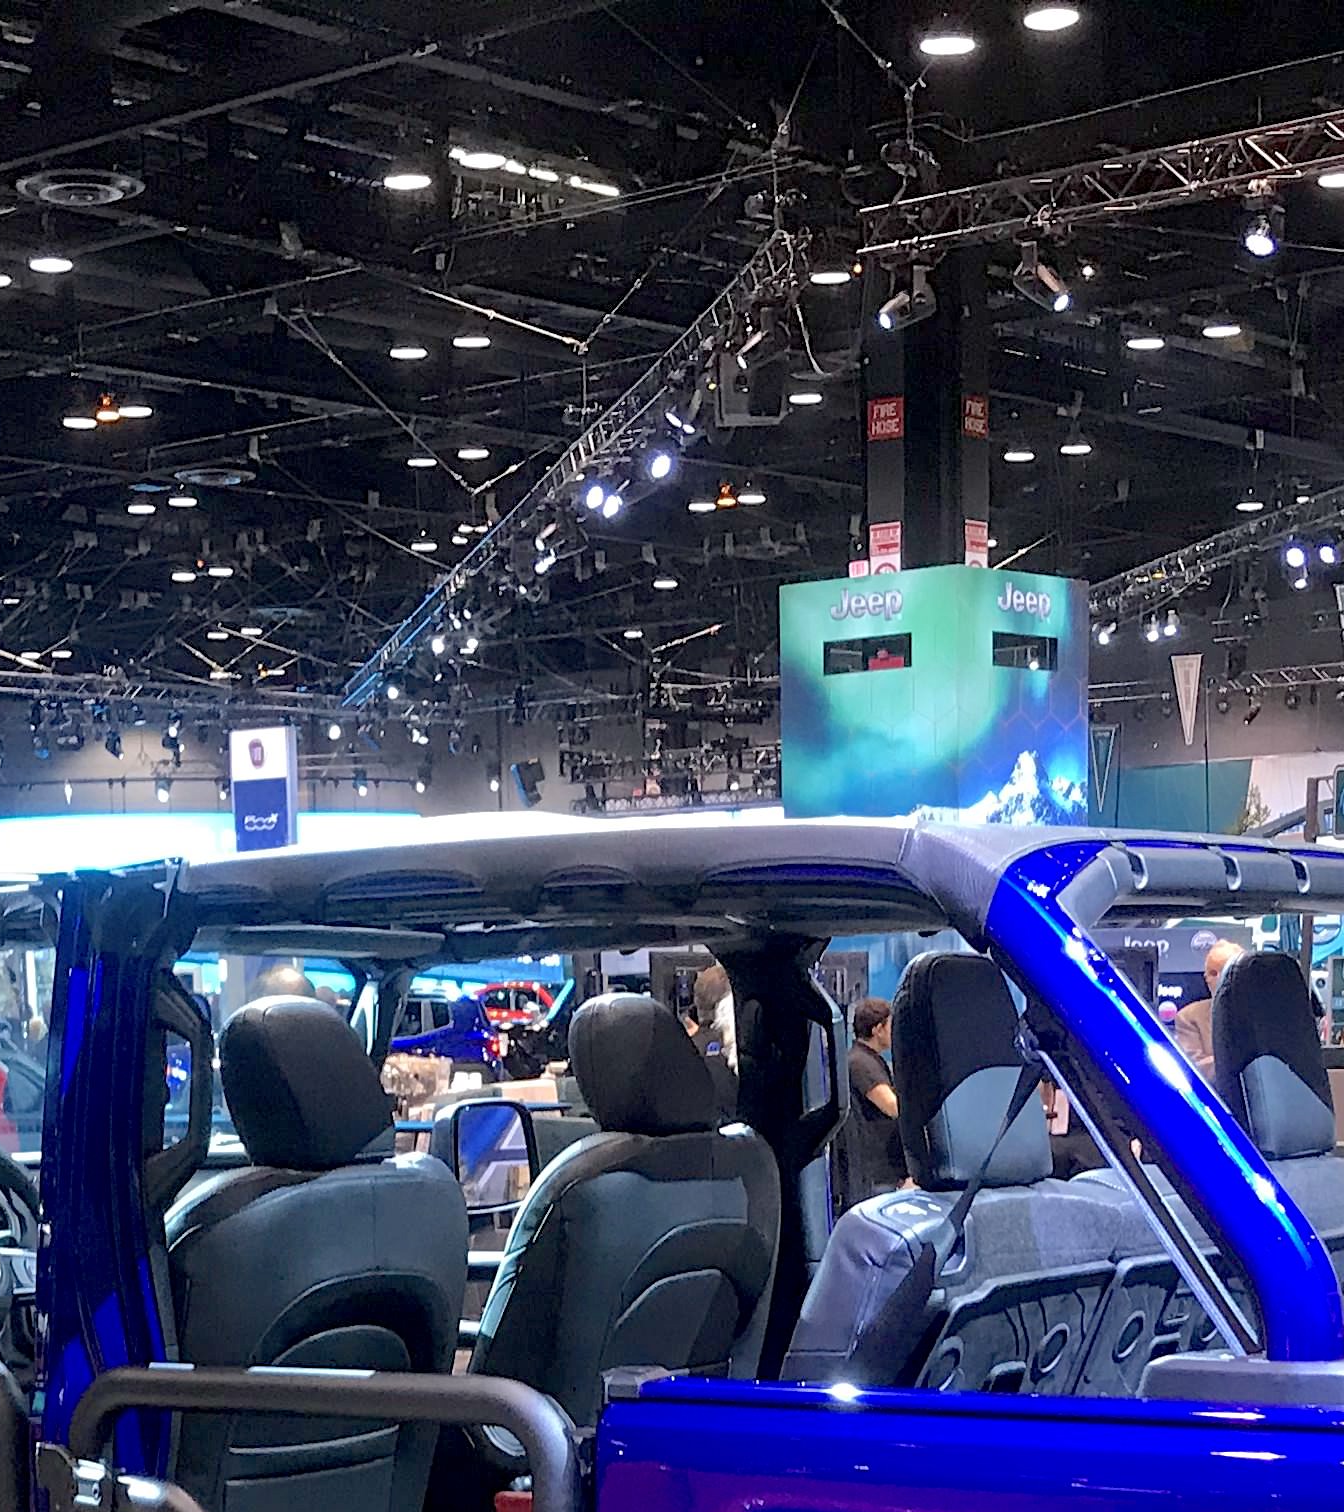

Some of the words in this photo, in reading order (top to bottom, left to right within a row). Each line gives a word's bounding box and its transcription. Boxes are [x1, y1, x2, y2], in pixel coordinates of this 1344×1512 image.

[873, 402, 897, 418] FIRE
[965, 400, 985, 417] FIRE
[872, 417, 900, 435] HOSE
[964, 416, 986, 433] HOSE
[830, 588, 903, 621] Jeep
[998, 582, 1051, 618] Jeep
